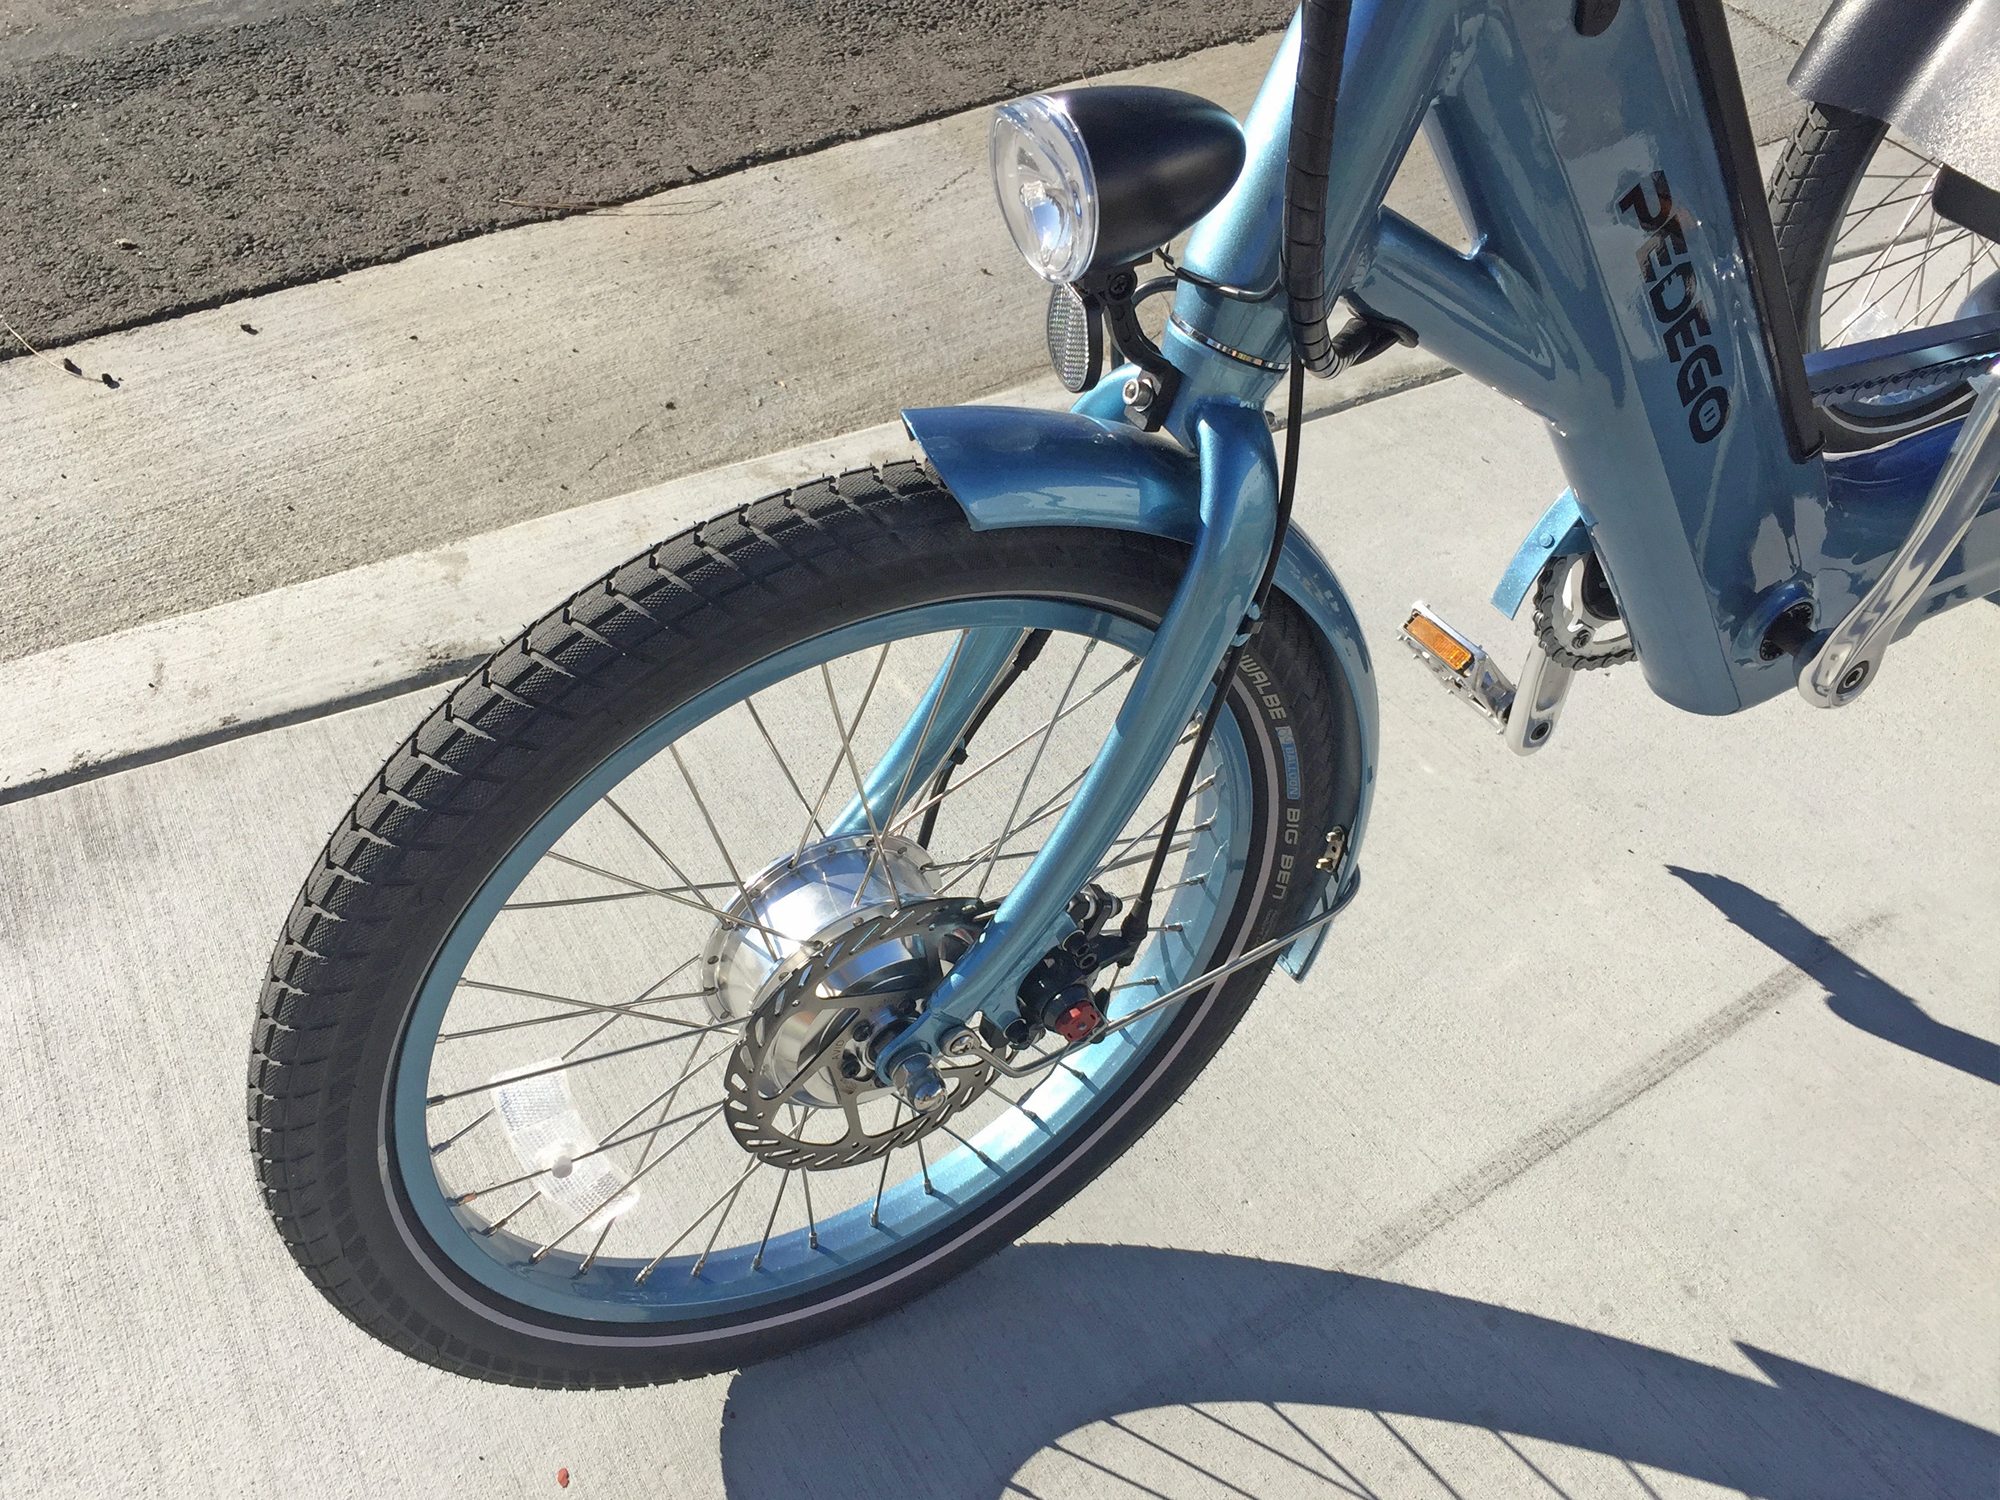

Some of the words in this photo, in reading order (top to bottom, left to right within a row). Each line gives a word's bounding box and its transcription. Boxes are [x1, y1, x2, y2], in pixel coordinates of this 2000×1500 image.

[1618, 169, 1731, 444] PEDEGO
[1284, 808, 1301, 845] BIG
[1272, 854, 1294, 900] BEN
[832, 1039, 845, 1060] AVID
